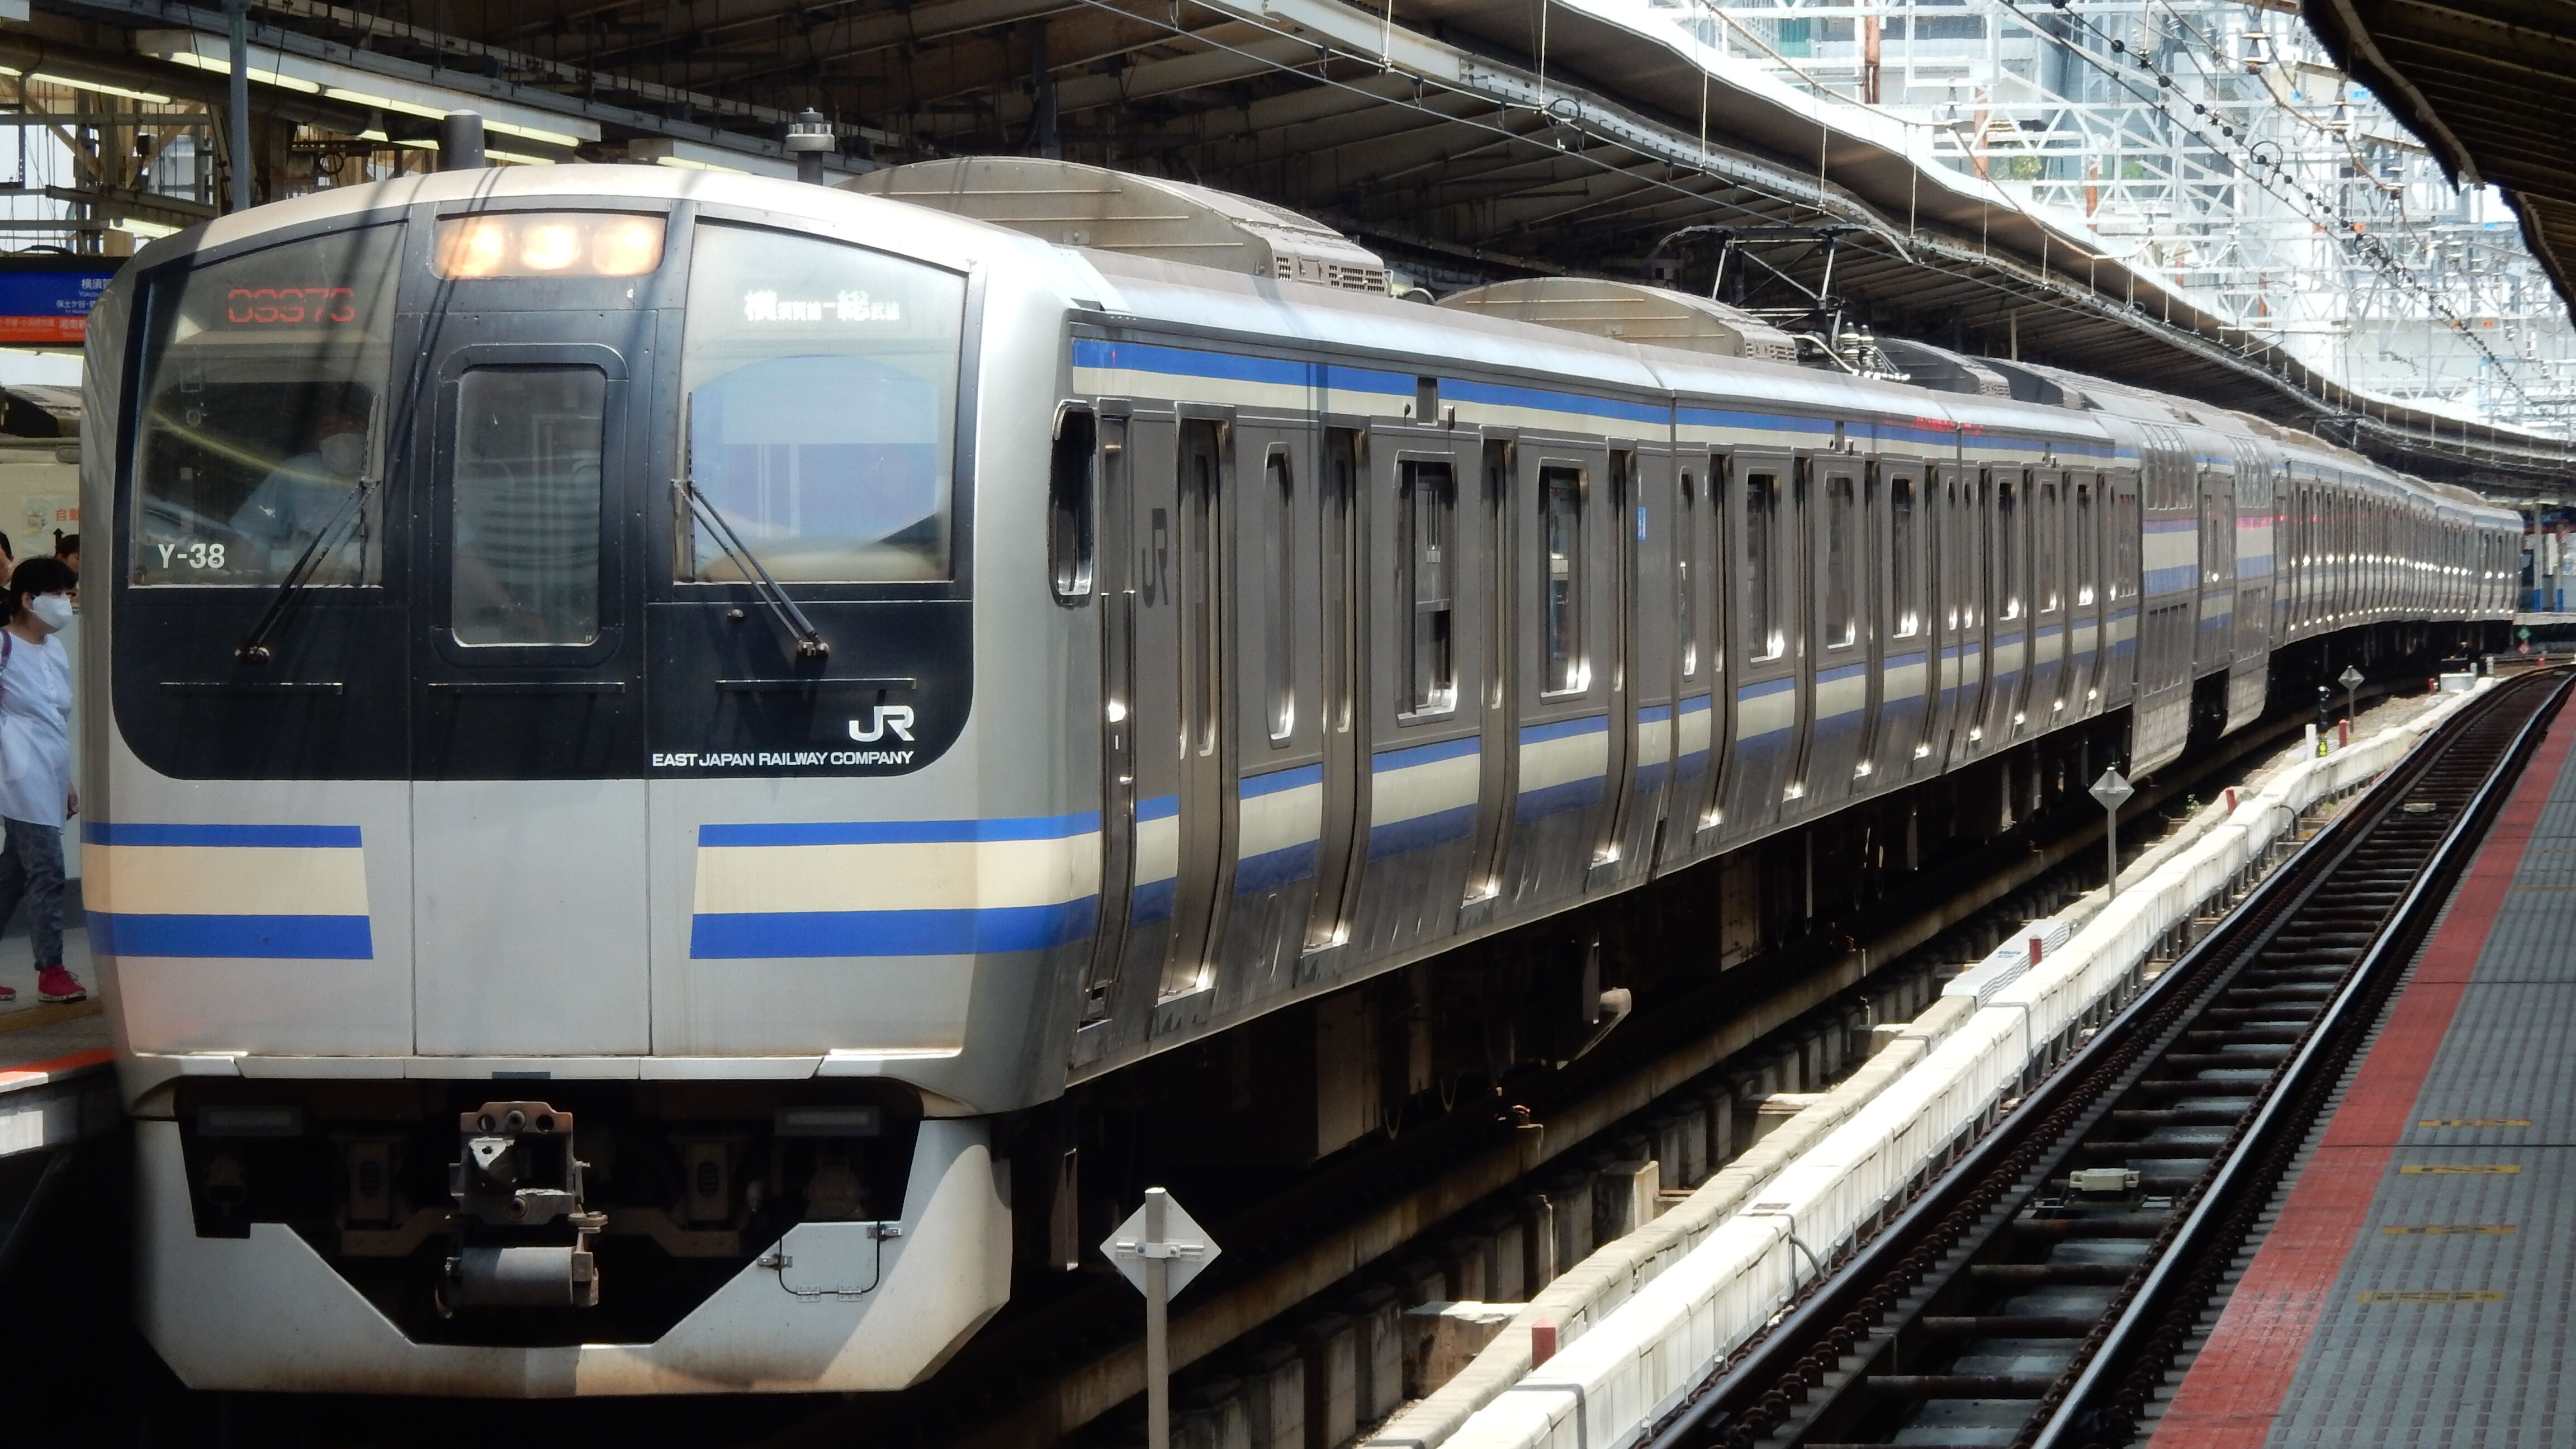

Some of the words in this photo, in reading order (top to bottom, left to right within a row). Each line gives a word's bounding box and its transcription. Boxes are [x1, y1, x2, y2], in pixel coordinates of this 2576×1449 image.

[158, 543, 225, 569] Y-38
[1142, 508, 1169, 608] JR
[849, 705, 915, 742] JR
[652, 753, 698, 766] EAST
[699, 752, 755, 766] JAPAN
[759, 752, 828, 766] RAILWAY
[831, 751, 915, 765] COMPANY
